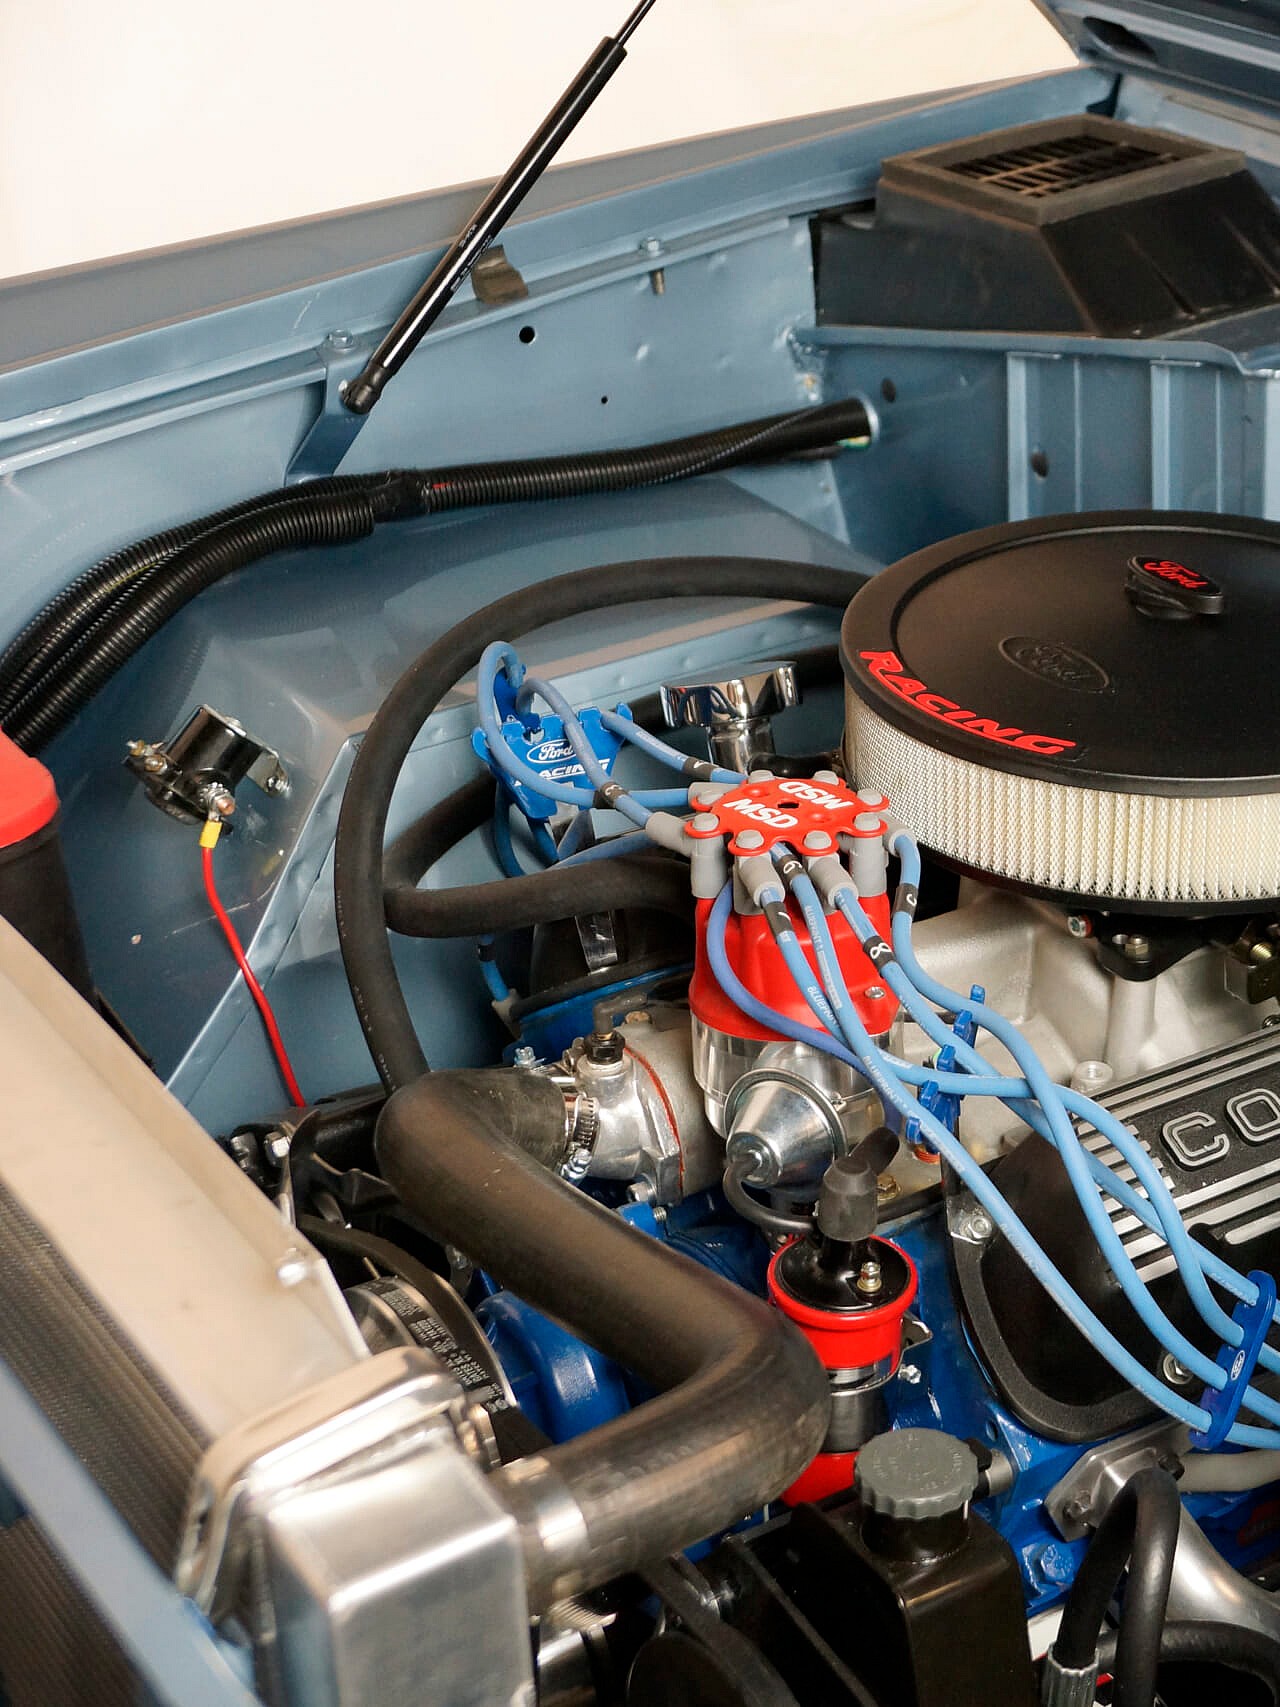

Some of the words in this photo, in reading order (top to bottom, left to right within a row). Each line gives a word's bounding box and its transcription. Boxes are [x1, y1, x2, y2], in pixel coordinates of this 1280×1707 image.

[1143, 560, 1207, 589] Ford
[859, 650, 1077, 755] RACING
[537, 741, 575, 762] Ford
[777, 781, 854, 811] MSD
[723, 797, 799, 829] MSD
